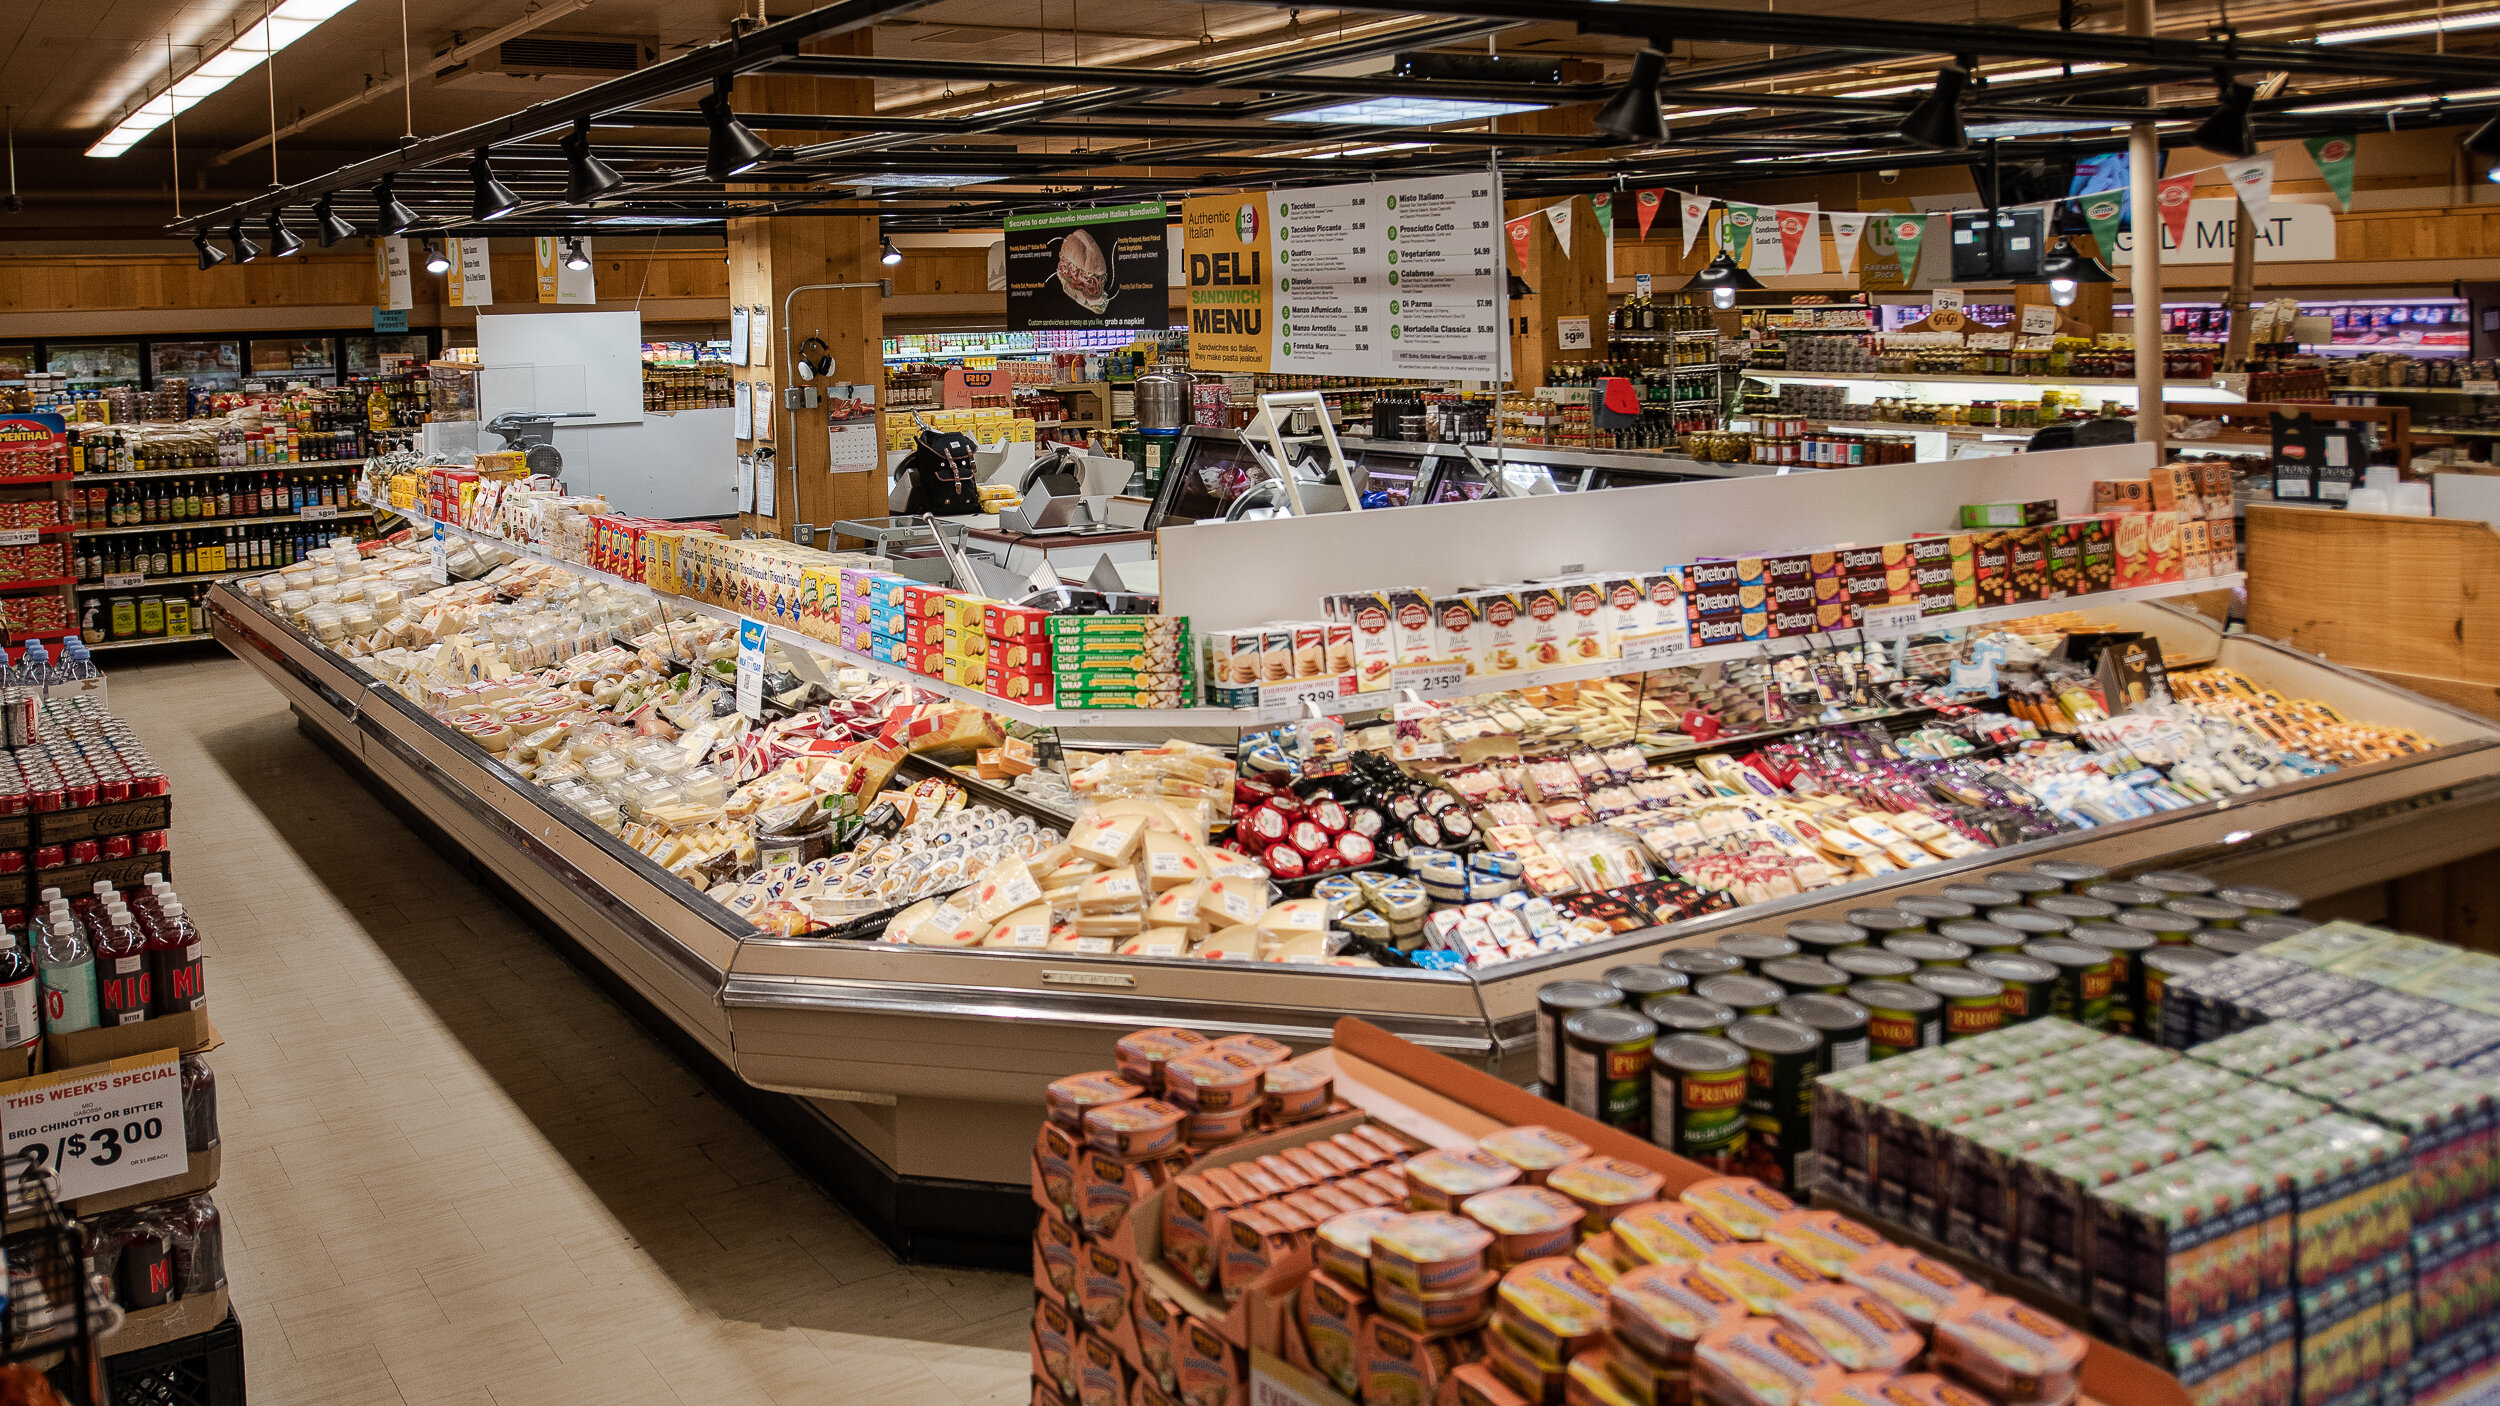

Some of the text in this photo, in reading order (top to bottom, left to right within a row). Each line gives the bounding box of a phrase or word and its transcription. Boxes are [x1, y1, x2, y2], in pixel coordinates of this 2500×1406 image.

[1419, 193, 1444, 201] Italiano
[1291, 202, 1315, 210] Tacchino
[1049, 215, 1075, 224] Authentic
[1077, 212, 1108, 222] Homemade
[1110, 209, 1128, 218] Italian
[1130, 207, 1159, 217] Sandwich
[1189, 211, 1230, 224] Authentic
[1242, 214, 1252, 223] 13
[1189, 227, 1214, 239] Italian
[1317, 224, 1341, 232] Piccante
[1400, 225, 1433, 233] Prosciutto
[1755, 225, 1780, 233] Condimen
[1756, 237, 1769, 245] Salad
[1401, 248, 1490, 259] Vegetariano $4.99
[1190, 252, 1260, 286] DELI
[1863, 263, 1902, 273] FARMER
[1192, 290, 1261, 304] SANDWICH
[1105, 317, 1118, 326] grab
[1124, 317, 1144, 326] napkin!
[1193, 309, 1261, 335] MENU
[1403, 325, 1438, 333] Mortadella
[1441, 325, 1471, 333] Classica
[1198, 343, 1229, 351] Sandwiches
[1239, 344, 1258, 353] Italian,
[1195, 352, 1263, 363] they make pasta jealous!
[966, 374, 990, 382] RIO
[1913, 542, 1949, 559] Breton
[2051, 544, 2080, 558] Breton
[2086, 541, 2114, 555] Breton
[709, 554, 724, 568] Triscuit
[1843, 550, 1882, 568] Breton
[1979, 553, 2007, 568] Breton
[2015, 548, 2044, 563] Breton
[725, 558, 738, 572] Triscuit
[740, 563, 752, 575] Triscui
[1770, 559, 1810, 577] Breton
[752, 567, 767, 580] Triscuit
[770, 570, 786, 584] Triscuit
[787, 574, 800, 587] Triscu
[1693, 564, 1737, 584] Breton
[1916, 567, 1953, 584] Breton
[1847, 575, 1886, 594] Breton
[1775, 585, 1815, 603] Breton
[1919, 592, 1955, 610] Breton
[1696, 593, 1739, 612] Breton
[1776, 611, 1816, 630] Breton
[1699, 619, 1742, 640] Breton
[93, 805, 158, 832] Coca-Cola
[91, 861, 156, 885] Coca-Col
[173, 964, 201, 998] MI
[104, 973, 150, 1009] MIO
[124, 1013, 140, 1022] BITTER
[7, 1067, 176, 1109] THIS WEEK'S SPECIAL
[8, 1101, 163, 1140] BRIO CHINOTTO OR BITTER
